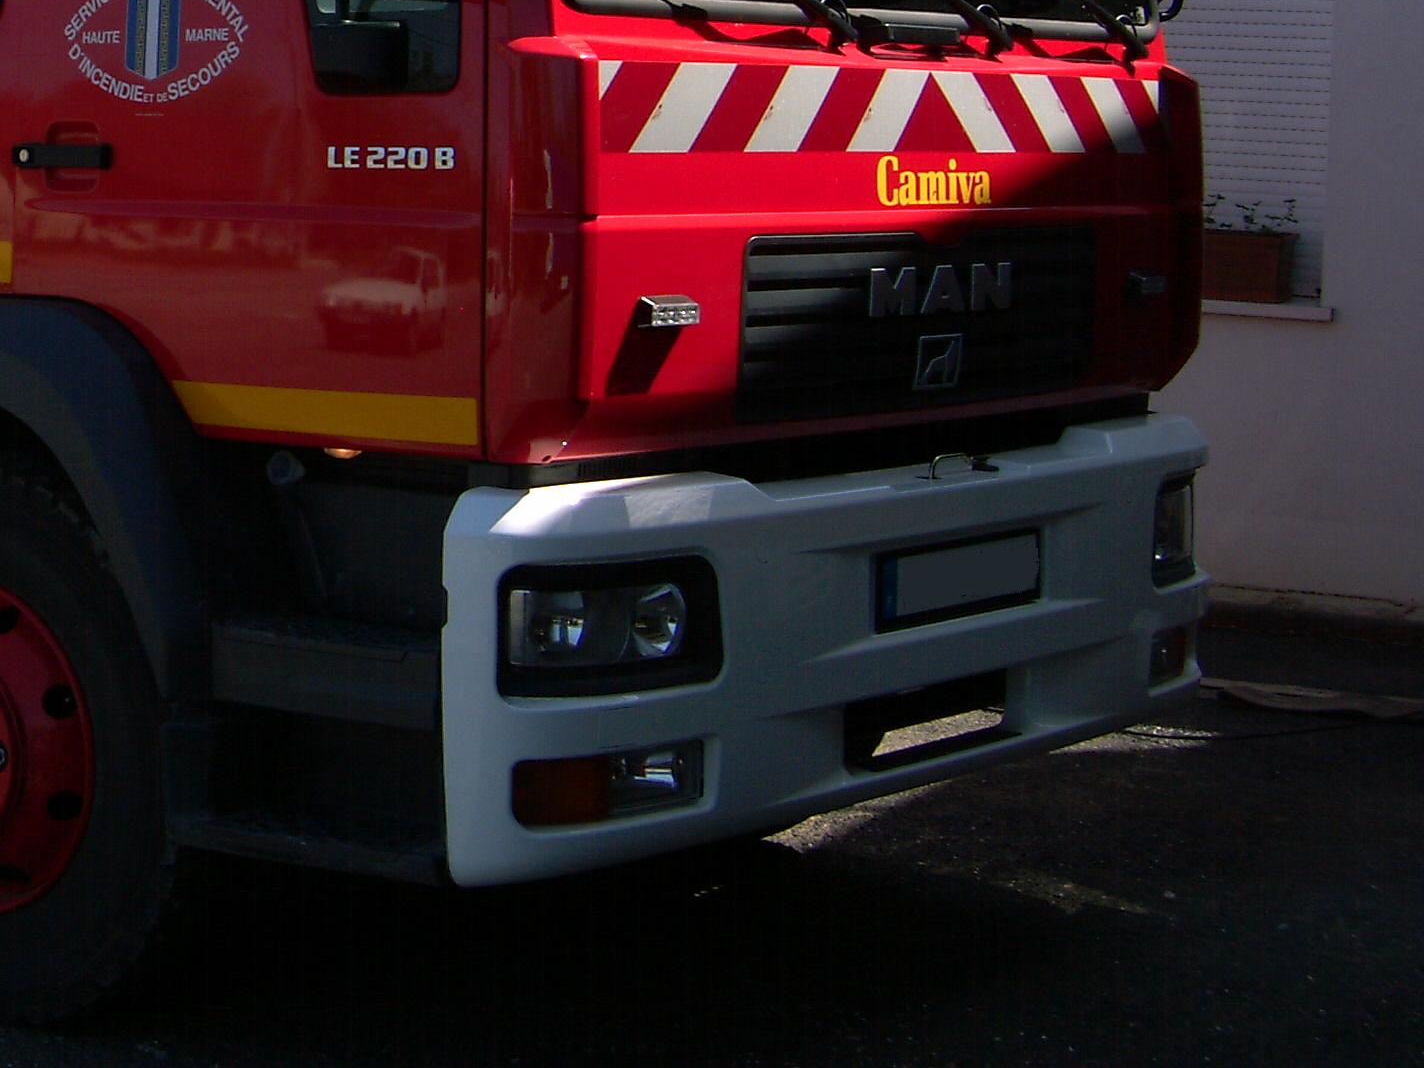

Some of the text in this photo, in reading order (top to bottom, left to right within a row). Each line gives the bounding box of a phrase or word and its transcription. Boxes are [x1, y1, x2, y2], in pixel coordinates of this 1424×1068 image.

[82, 27, 229, 44] HAUTE MARNE
[68, 41, 240, 103] D'INCENDIE ET DE SECOURS
[327, 146, 455, 169] LE 220 B
[876, 155, 992, 207] Camiva
[869, 262, 1012, 317] MAN
